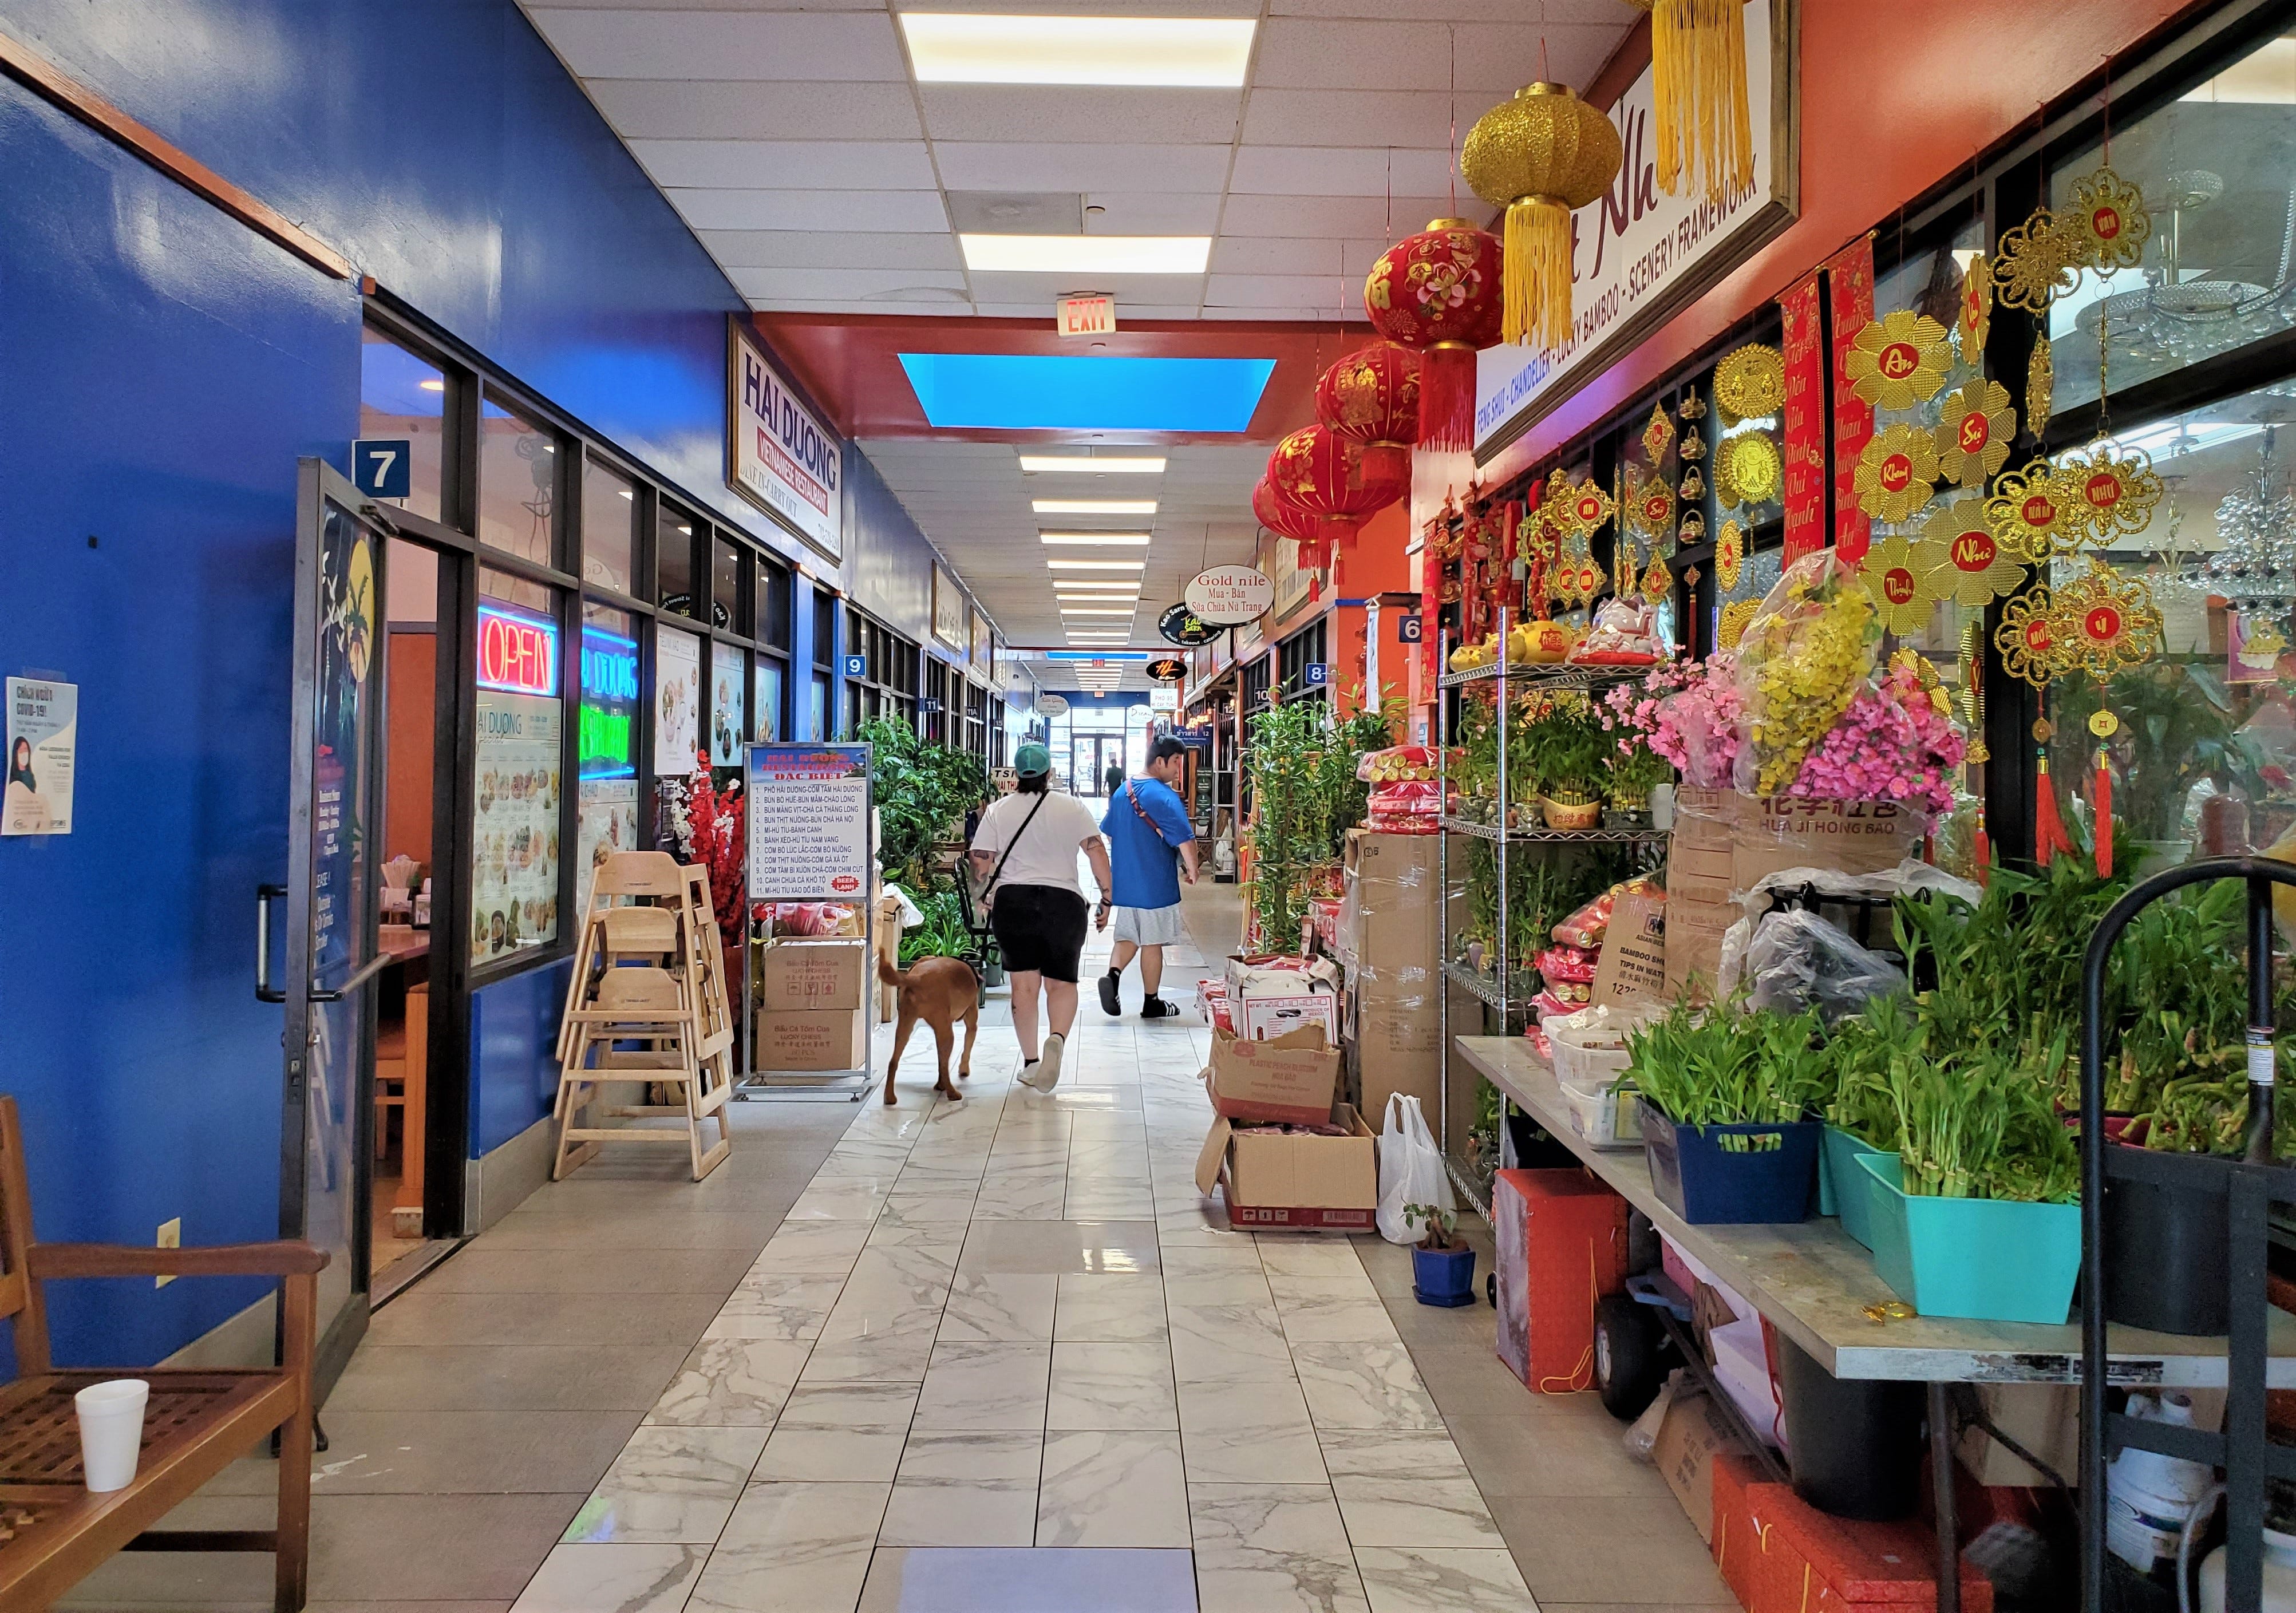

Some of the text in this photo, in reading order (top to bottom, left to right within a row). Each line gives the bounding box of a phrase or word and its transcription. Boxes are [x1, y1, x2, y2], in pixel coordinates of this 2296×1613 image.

[1067, 299, 1106, 332] EXIT
[1477, 402, 1490, 435] FENG
[1491, 387, 1505, 423] SHUI
[1511, 346, 1550, 406] CHANDELIER
[1557, 318, 1580, 365] LUCKY
[1583, 282, 1619, 343] BAMBOO
[1629, 230, 1674, 302] SCENERY
[1885, 349, 1914, 374] An
[745, 352, 778, 436] HAI
[370, 451, 397, 488] 7
[760, 434, 827, 513] VIETNAMESE RESTAURANT
[1198, 575, 1266, 586] Gold nile
[1208, 588, 1224, 598] Mua
[1241, 601, 1262, 613] Trang
[1160, 606, 1185, 628] Kao Sarn
[1405, 619, 1420, 639] 6
[1203, 630, 1222, 643] catering
[486, 618, 551, 691] OPEN
[849, 659, 860, 673] 9
[1311, 667, 1322, 680] 8
[1255, 690, 1269, 700] 10
[926, 701, 936, 710] 11
[967, 707, 977, 715] 11A
[1224, 705, 1234, 714] 12
[1760, 819, 1895, 835] HUA JI HONG BAO
[1635, 934, 1653, 944] ASIAN
[1620, 947, 1650, 960] BAMBOO
[1620, 960, 1635, 970] TIPS
[1636, 964, 1644, 972] IN
[1249, 1059, 1271, 1069] PLASTIC
[1273, 1061, 1291, 1070] PEACH
